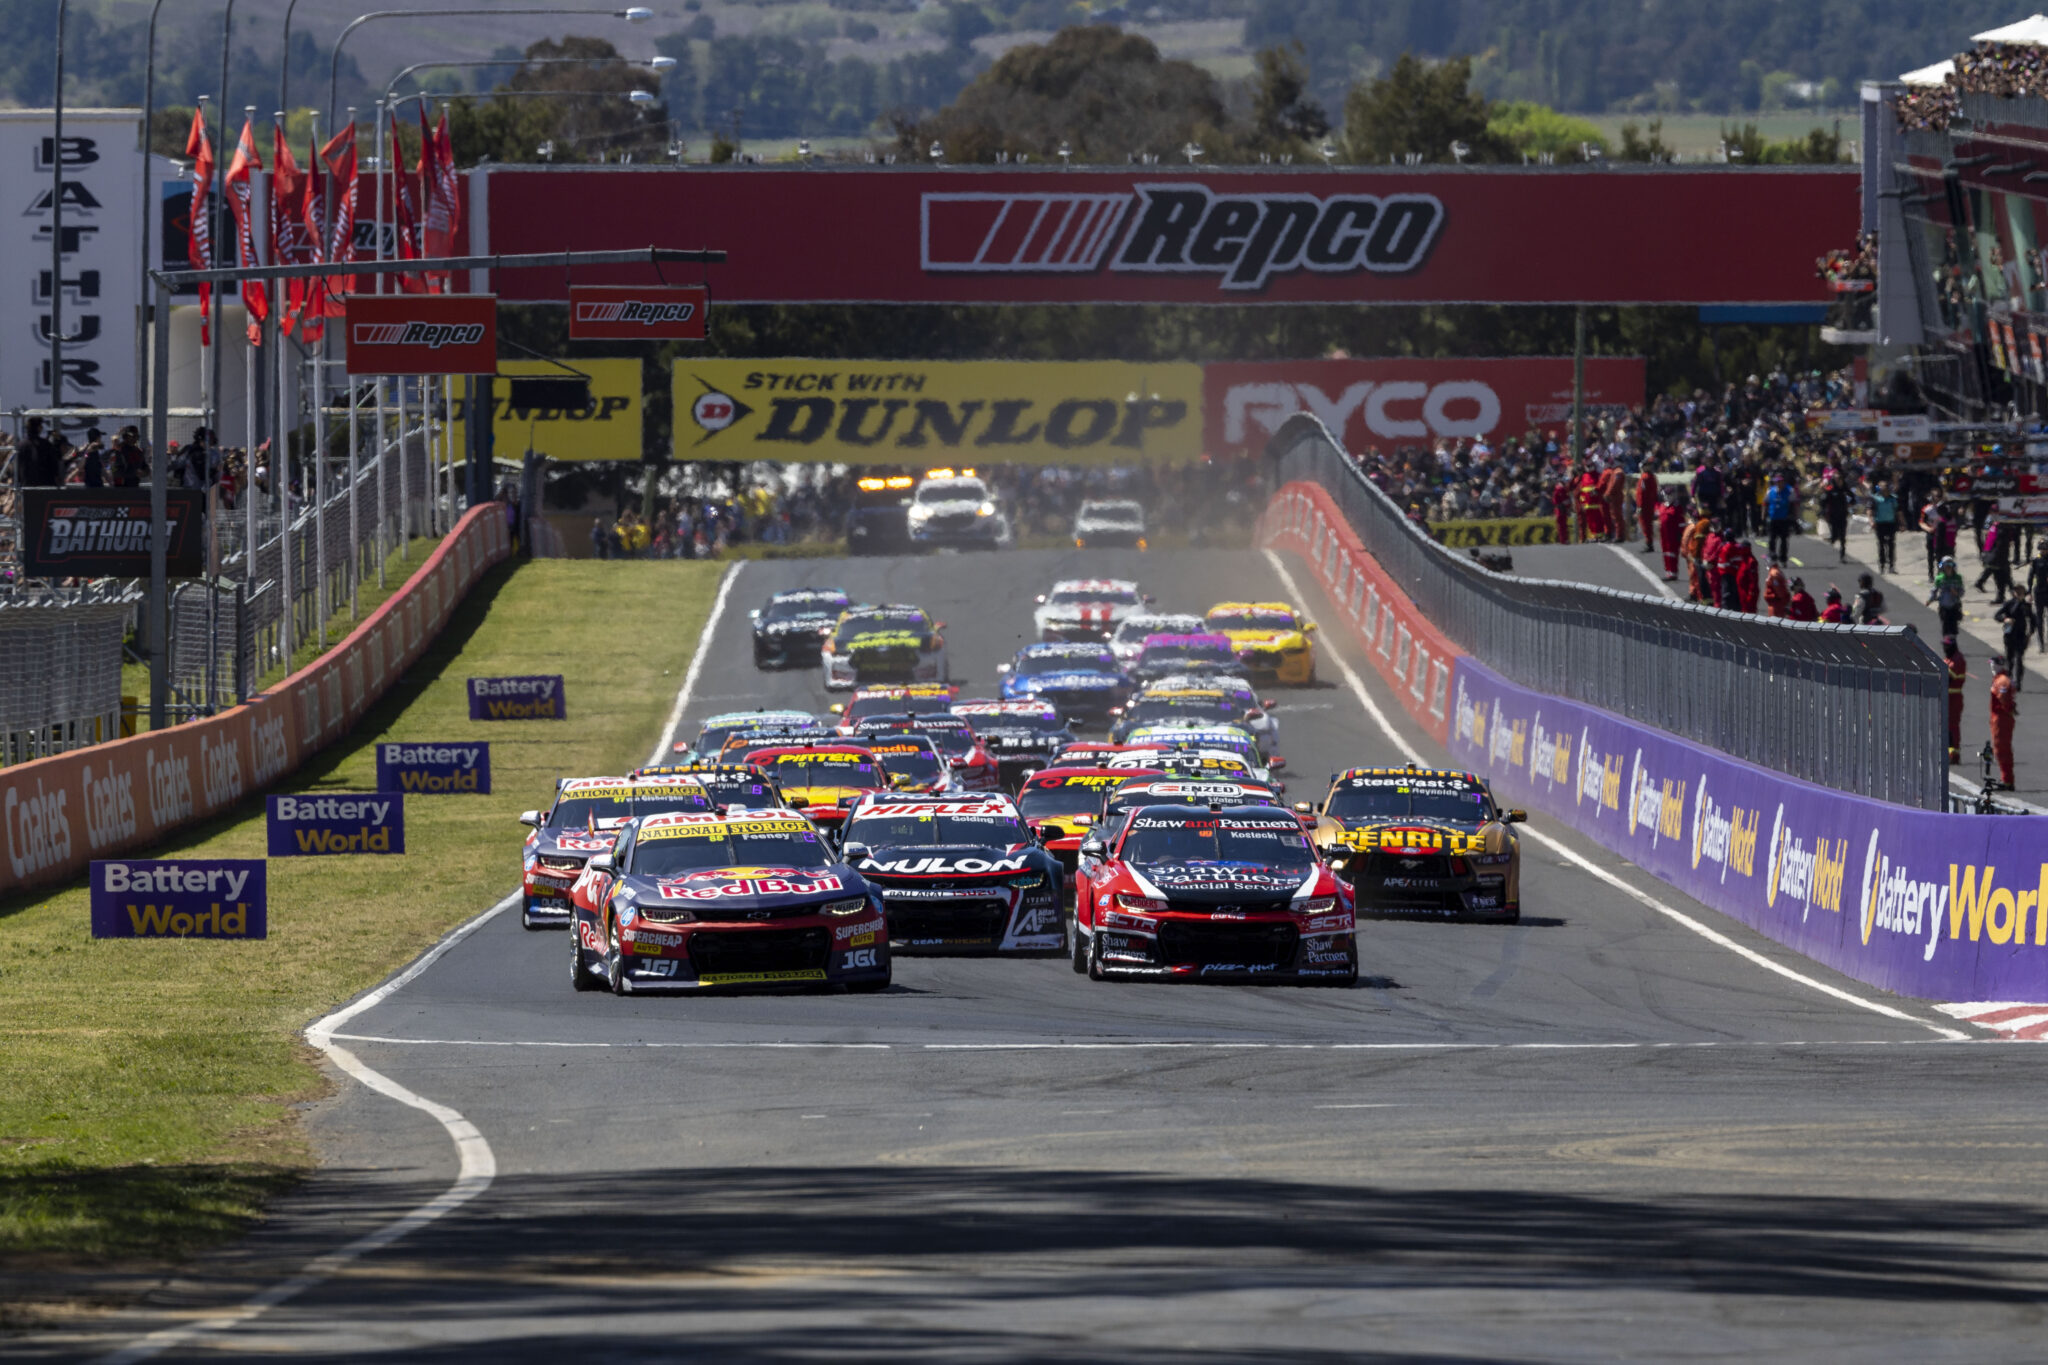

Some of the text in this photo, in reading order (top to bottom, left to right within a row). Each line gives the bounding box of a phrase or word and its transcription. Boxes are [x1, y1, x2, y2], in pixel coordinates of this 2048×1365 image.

[1113, 183, 1443, 288] Repco
[619, 301, 695, 325] Repco
[401, 321, 484, 348] Repco
[743, 373, 927, 392] STICK WITH
[754, 397, 1188, 447] DUNLOP
[1225, 380, 1501, 445] RYCO
[48, 518, 177, 554] BATHURT
[474, 678, 555, 698] Battery
[488, 698, 556, 717] World
[385, 745, 479, 769] Battery
[777, 753, 862, 764] PIRTEK
[400, 769, 478, 791] World
[1065, 776, 1131, 786] PIRT
[1355, 768, 1464, 778] PENRITE
[146, 744, 193, 828] Coates
[570, 779, 697, 788] AMOL
[1181, 785, 1234, 793] ENZED
[1352, 778, 1446, 788] Steadfast
[1412, 788, 1458, 796] Reynolds
[563, 788, 629, 799] NATIONAL
[82, 760, 136, 849] Coates
[276, 796, 390, 826] Battery
[862, 804, 1005, 816] HIFLEX
[5, 777, 71, 879] Coates
[951, 815, 994, 824] Golding
[295, 826, 390, 851] World
[641, 822, 808, 839] NATIONAL STORAGE
[742, 833, 790, 841] Feeney
[1231, 831, 1278, 840] Kostecki
[1336, 831, 1486, 851] PENRITE
[858, 854, 1028, 873] NULON
[104, 863, 249, 901] Battery
[660, 876, 843, 900] Red Bull
[1154, 882, 1301, 891] Financial Services
[952, 889, 997, 897] ISUZU
[1875, 855, 2048, 961] Battery Worl
[126, 902, 247, 935] World
[622, 929, 683, 947] SUPERCHEAP
[836, 916, 884, 941] SUPERCHEAP
[853, 934, 873, 944] AUTO
[1102, 933, 1129, 948] Shaw
[1306, 938, 1334, 951] Shaw
[1308, 951, 1348, 963] Partners
